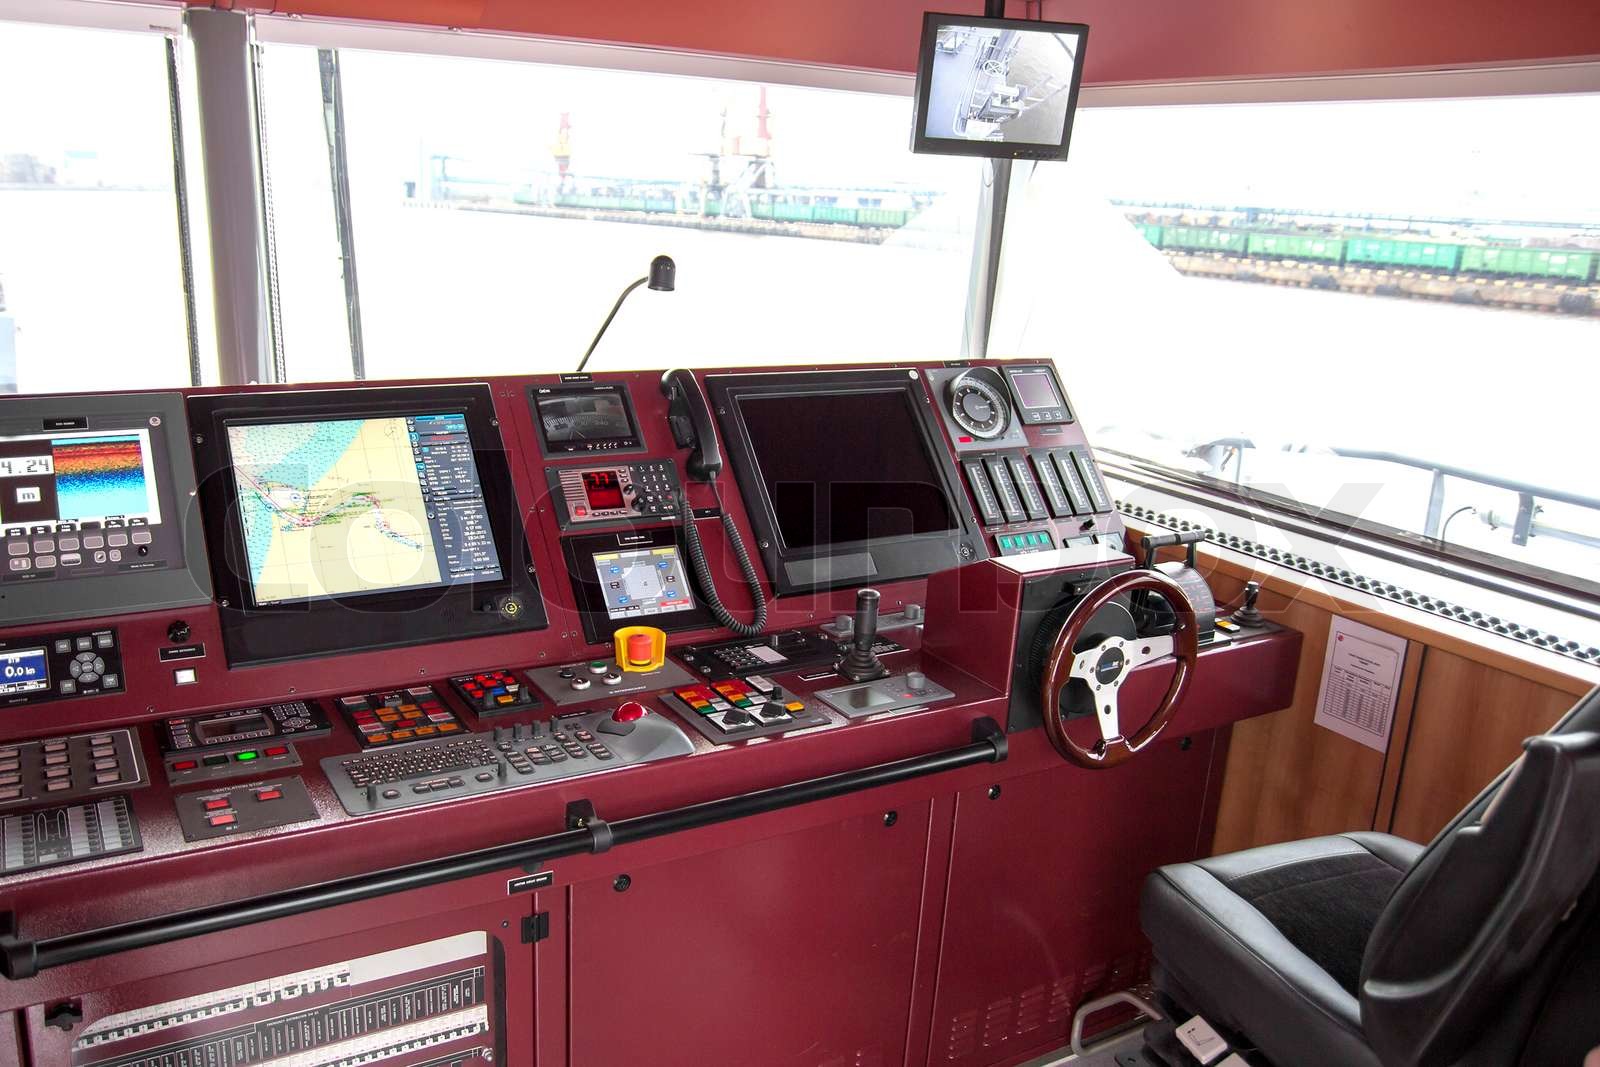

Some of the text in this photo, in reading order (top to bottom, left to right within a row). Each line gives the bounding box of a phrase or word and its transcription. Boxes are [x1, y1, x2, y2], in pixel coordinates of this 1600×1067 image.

[1, 458, 49, 474] 4.24
[22, 492, 36, 500] m
[5, 666, 24, 678] 0.0
